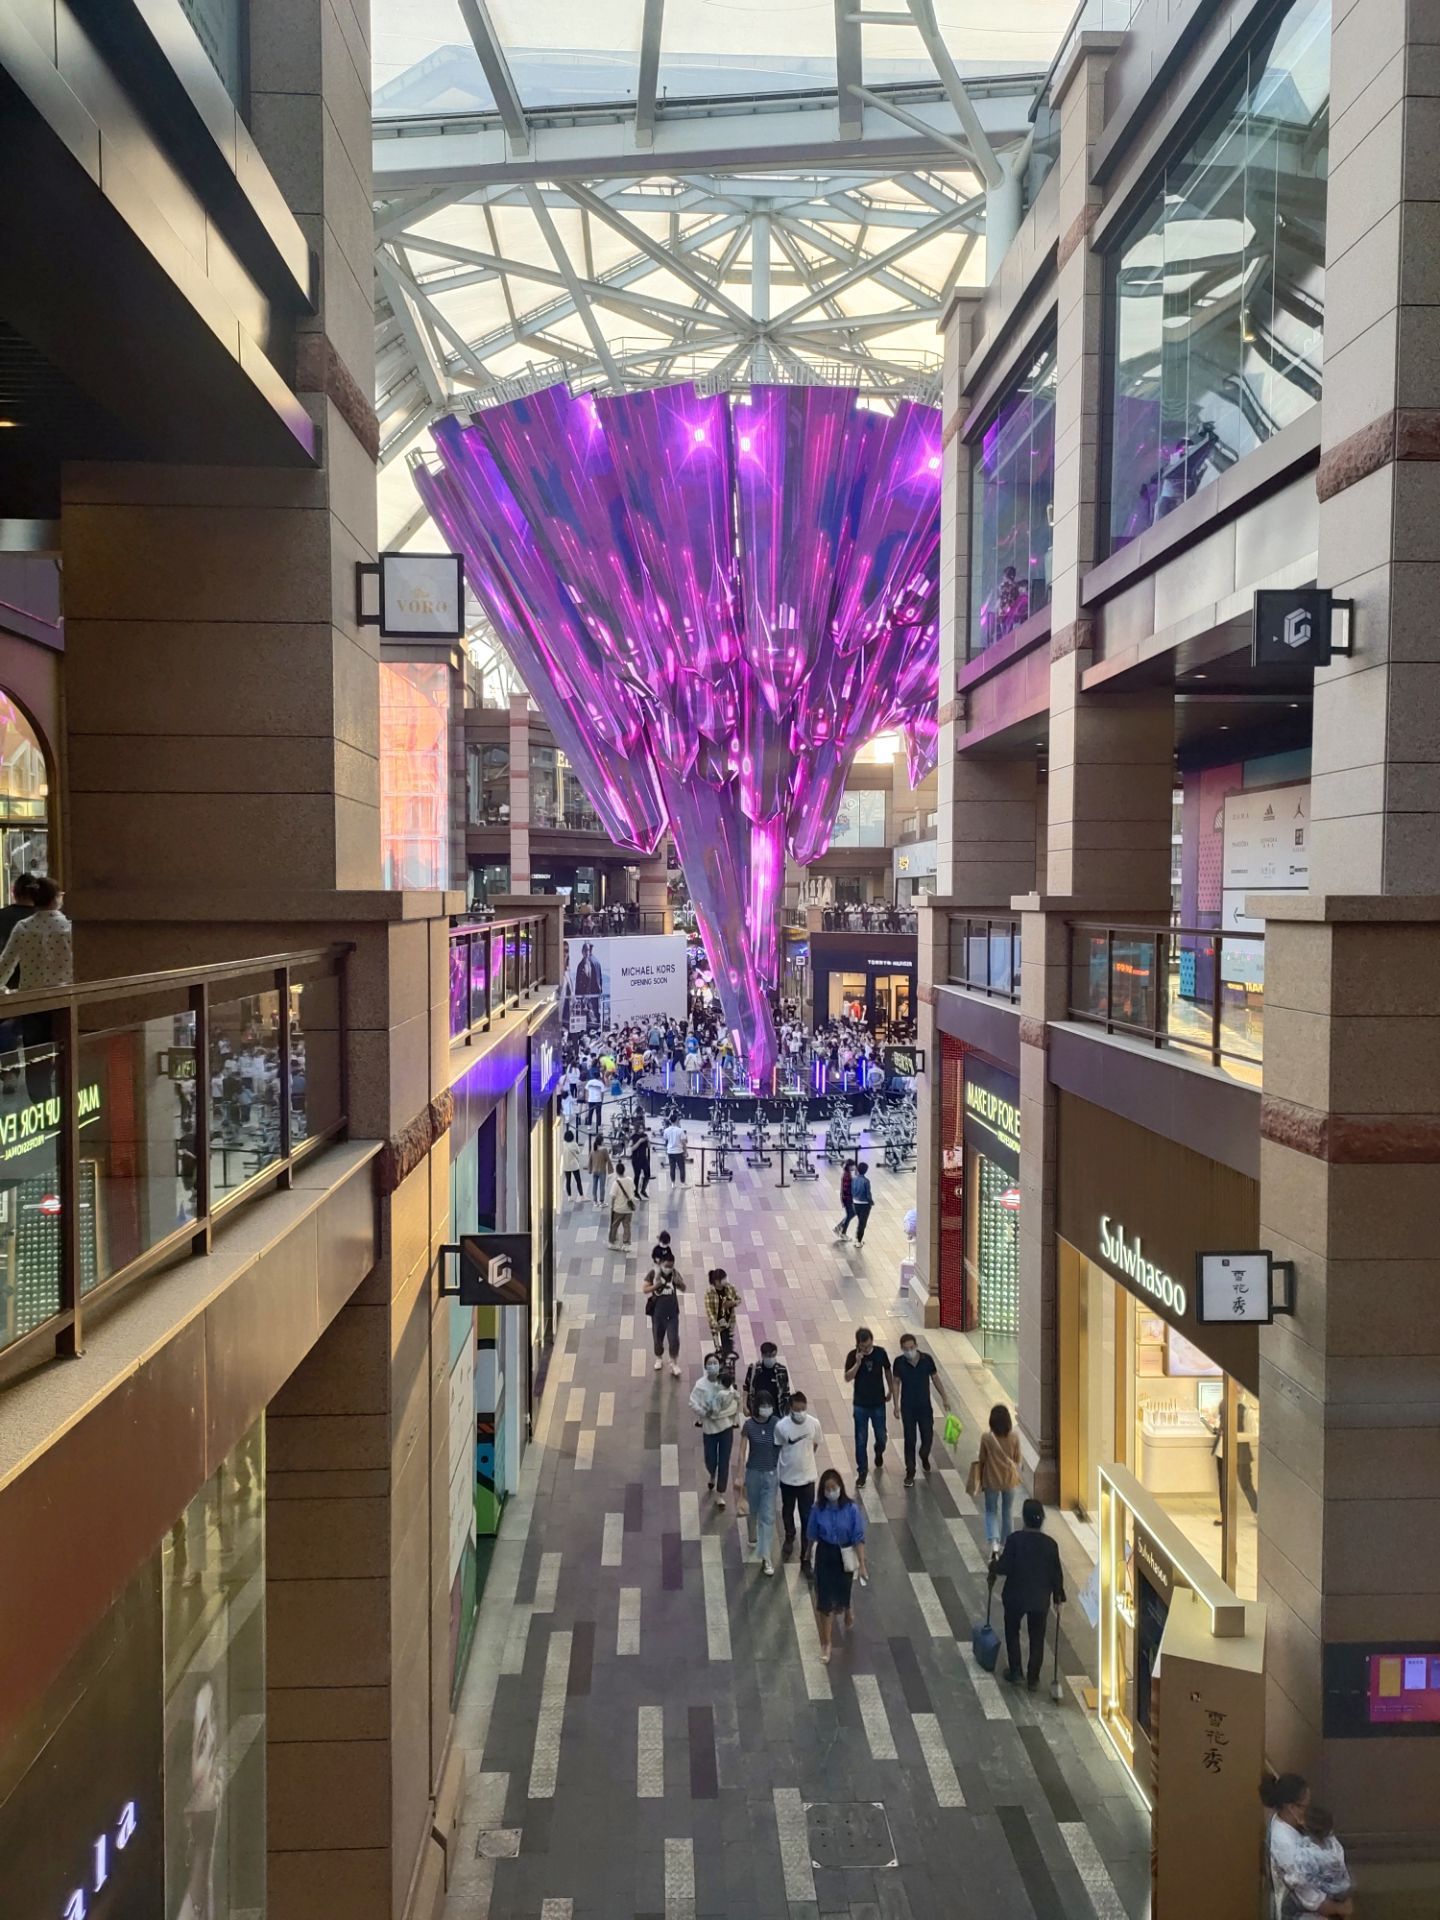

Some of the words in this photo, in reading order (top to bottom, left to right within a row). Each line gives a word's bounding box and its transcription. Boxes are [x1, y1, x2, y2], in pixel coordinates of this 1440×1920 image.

[621, 966, 654, 977] MICHAEL
[656, 964, 676, 974] KORS
[630, 979, 652, 987] OPENING
[653, 977, 668, 985] SOON
[967, 1081, 987, 1116] MAKE
[987, 1093, 997, 1121] UP
[997, 1099, 1014, 1135] FOR
[1100, 1215, 1187, 1317] Sulwhasoo
[1231, 1269, 1250, 1316] 雪花秀
[1137, 1536, 1168, 1587] Sulwhasoo
[1202, 1708, 1230, 1775] 雪花秀
